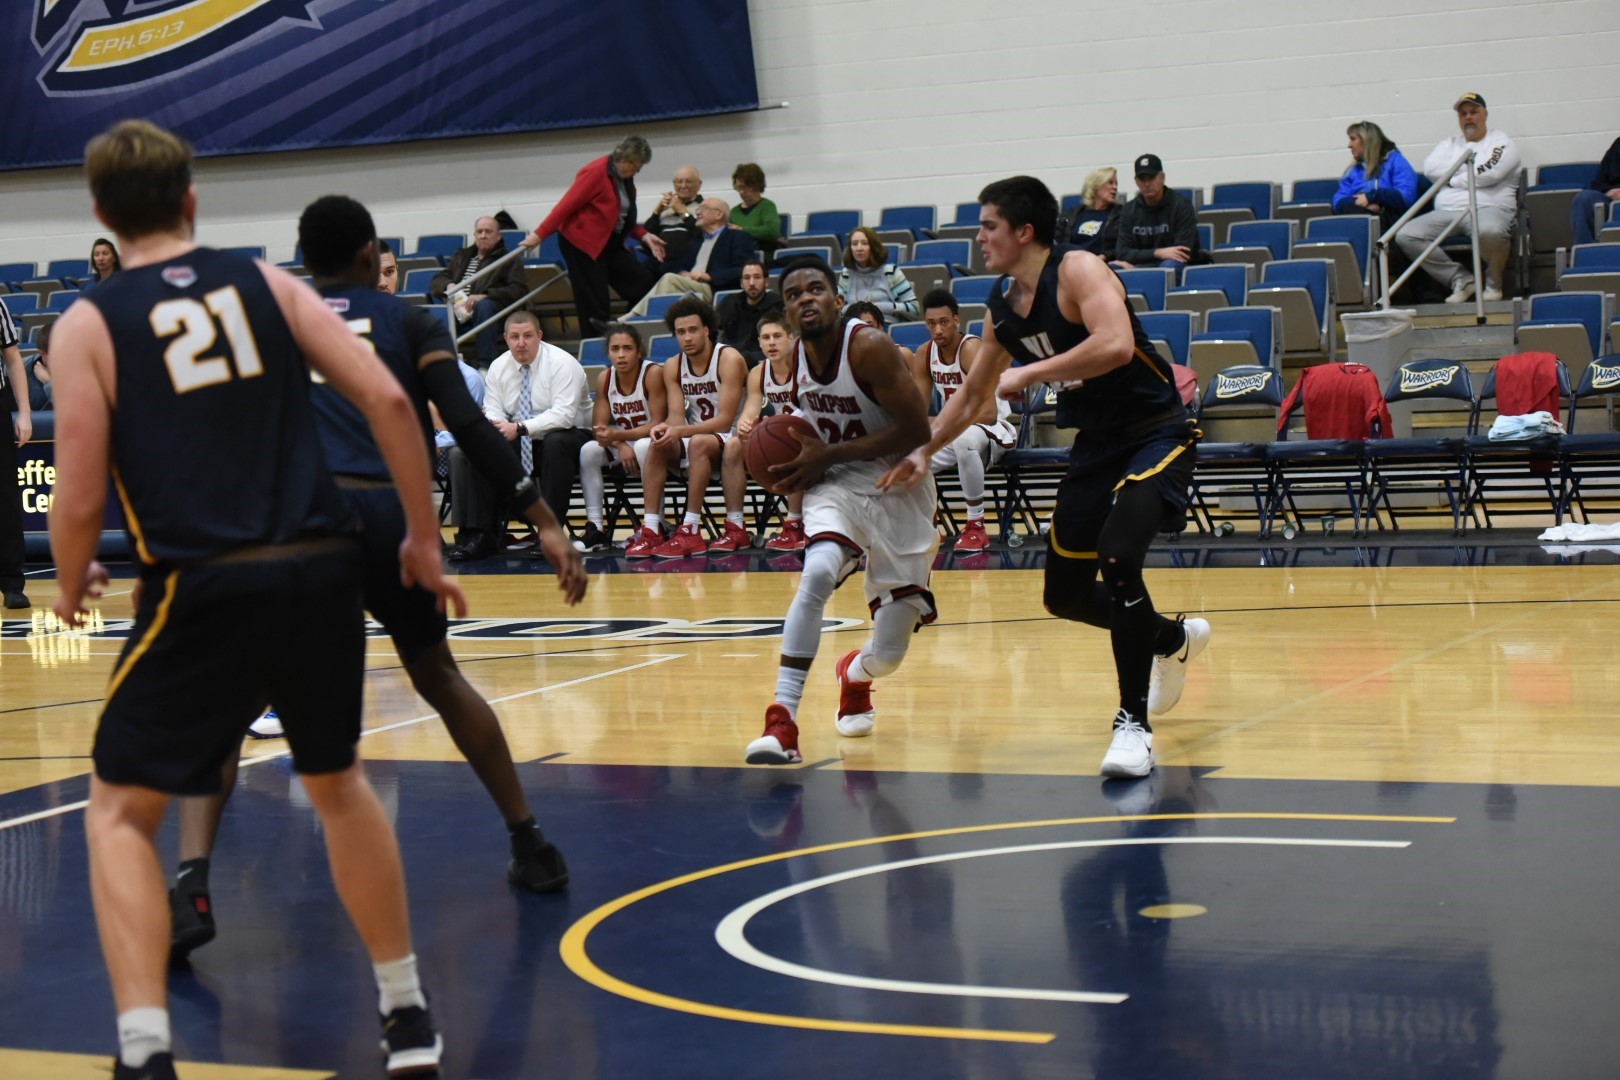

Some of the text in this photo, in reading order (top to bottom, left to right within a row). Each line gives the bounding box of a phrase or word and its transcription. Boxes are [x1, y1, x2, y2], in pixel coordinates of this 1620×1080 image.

[1477, 145, 1505, 174] ORBAN
[148, 283, 264, 394] 21
[1217, 372, 1272, 395] WARRIORS
[1401, 366, 1458, 389] WARRIORS
[1592, 363, 1620, 387] WAR
[682, 381, 717, 396] SIMPSON
[767, 391, 791, 404] SIMP
[612, 400, 645, 415] SIMPSON
[696, 398, 715, 422] 0
[806, 392, 862, 415] SIMPSON
[816, 417, 868, 444] 24
